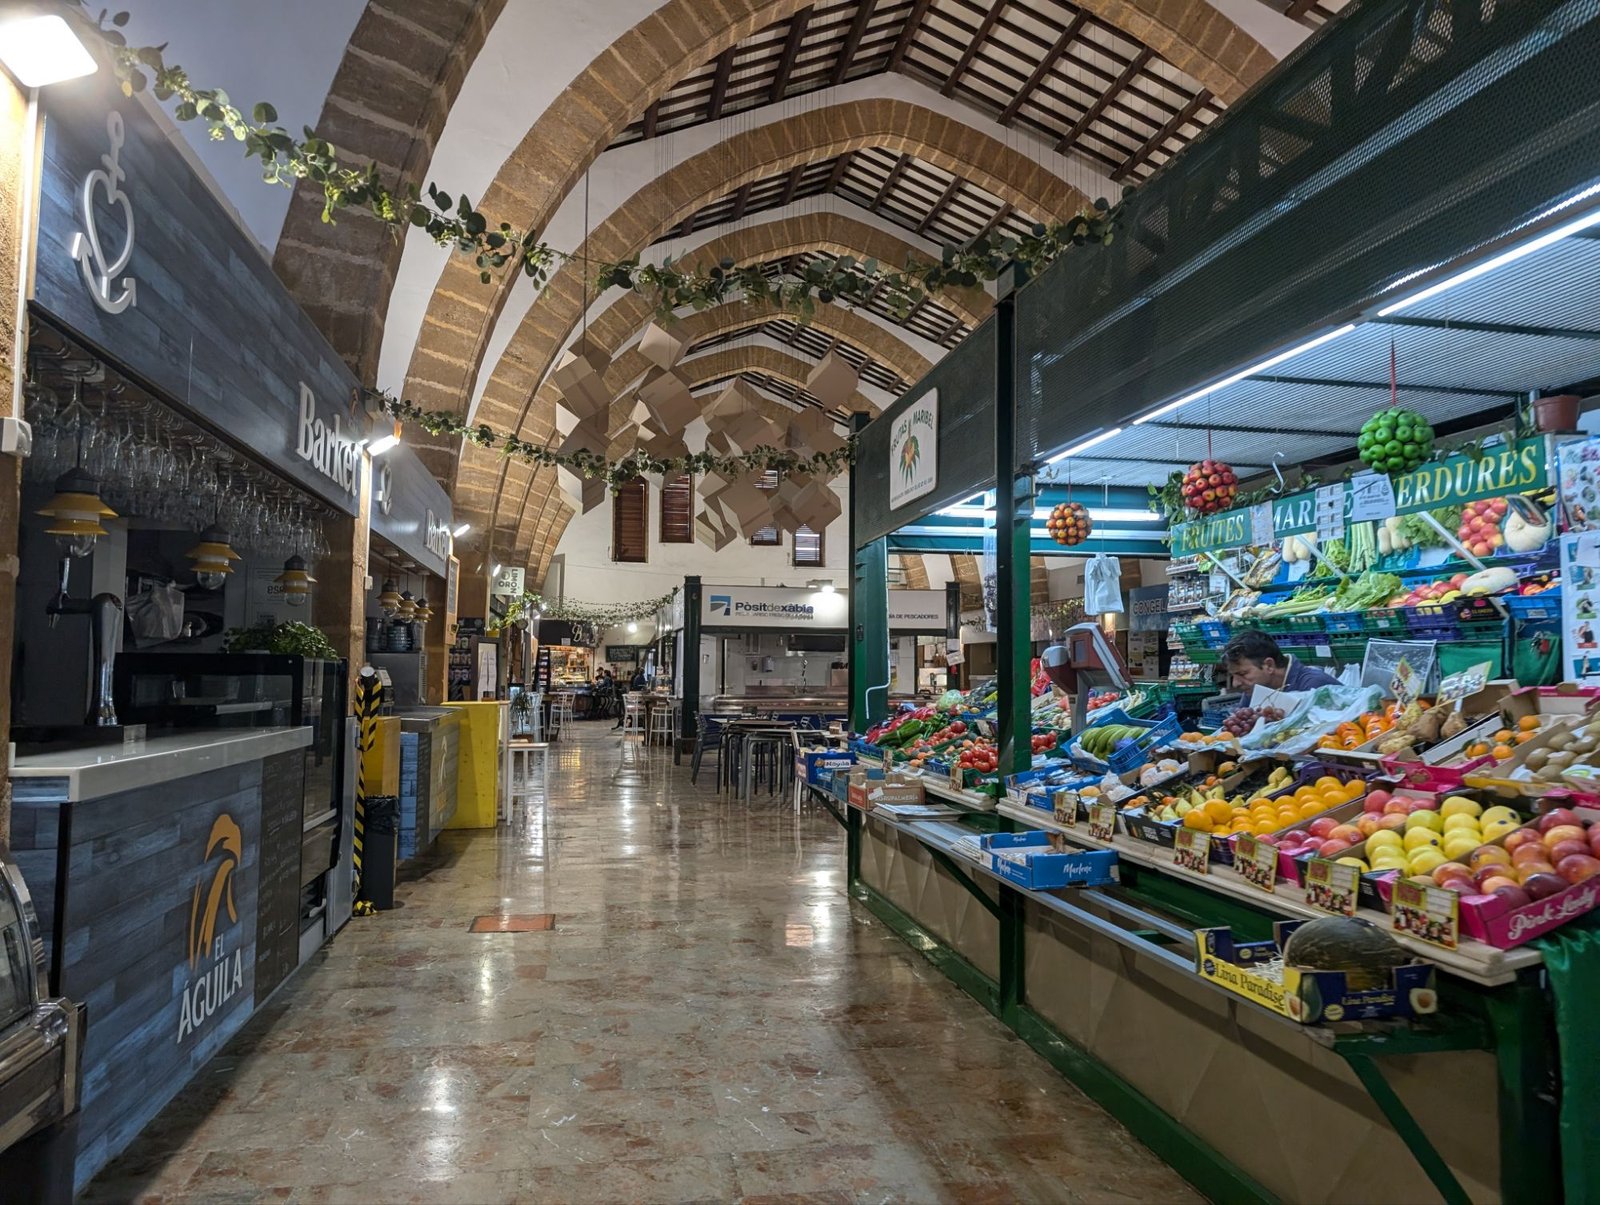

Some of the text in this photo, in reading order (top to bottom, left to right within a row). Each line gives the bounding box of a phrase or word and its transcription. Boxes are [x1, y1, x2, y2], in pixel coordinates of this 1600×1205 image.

[297, 381, 360, 496] Barket
[913, 409, 935, 430] MARIBEL
[1180, 514, 1245, 552] FRUITES
[1063, 862, 1093, 878] Marlene
[1508, 887, 1597, 940] Pink Lady
[215, 933, 225, 961] EL
[177, 948, 243, 1043] ÁGUILA
